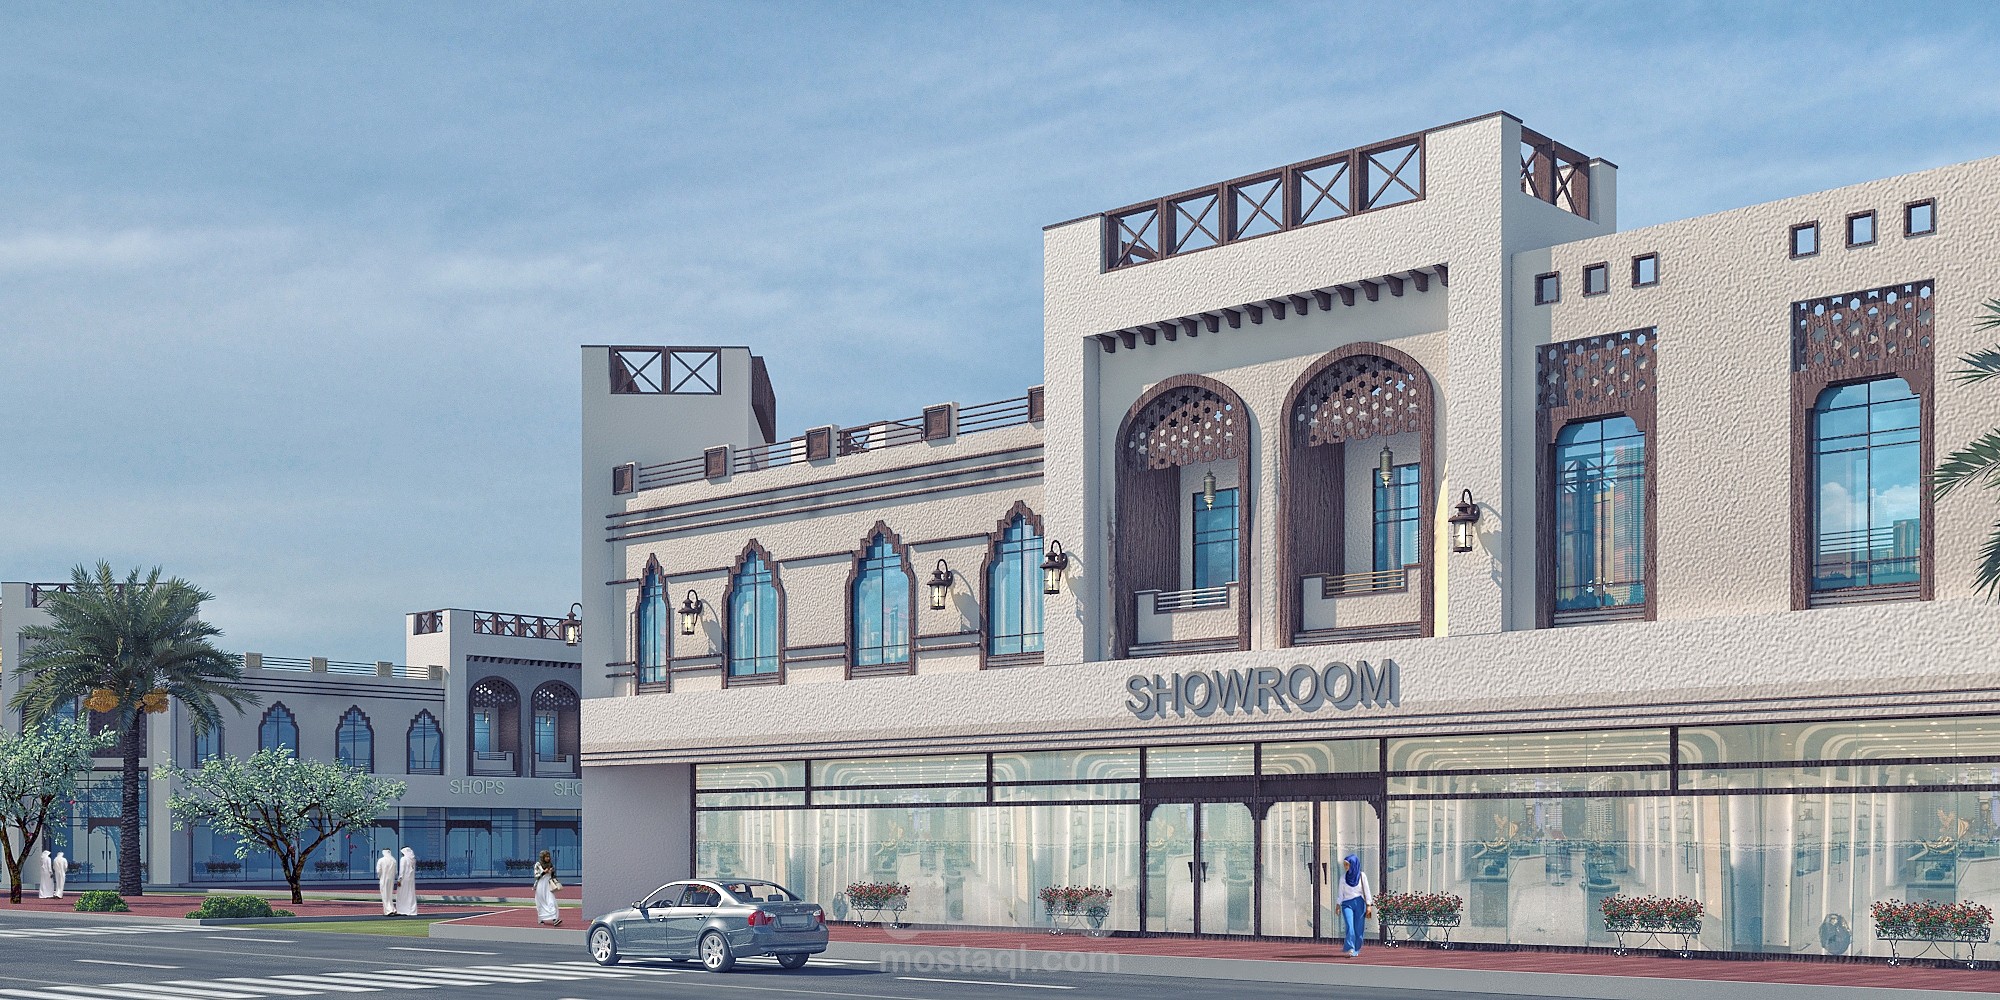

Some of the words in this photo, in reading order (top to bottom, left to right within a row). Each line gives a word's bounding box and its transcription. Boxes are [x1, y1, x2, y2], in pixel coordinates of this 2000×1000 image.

[1125, 658, 1397, 718] SHOWROOM
[449, 779, 505, 795] SHOPS
[553, 781, 582, 796] SHO
